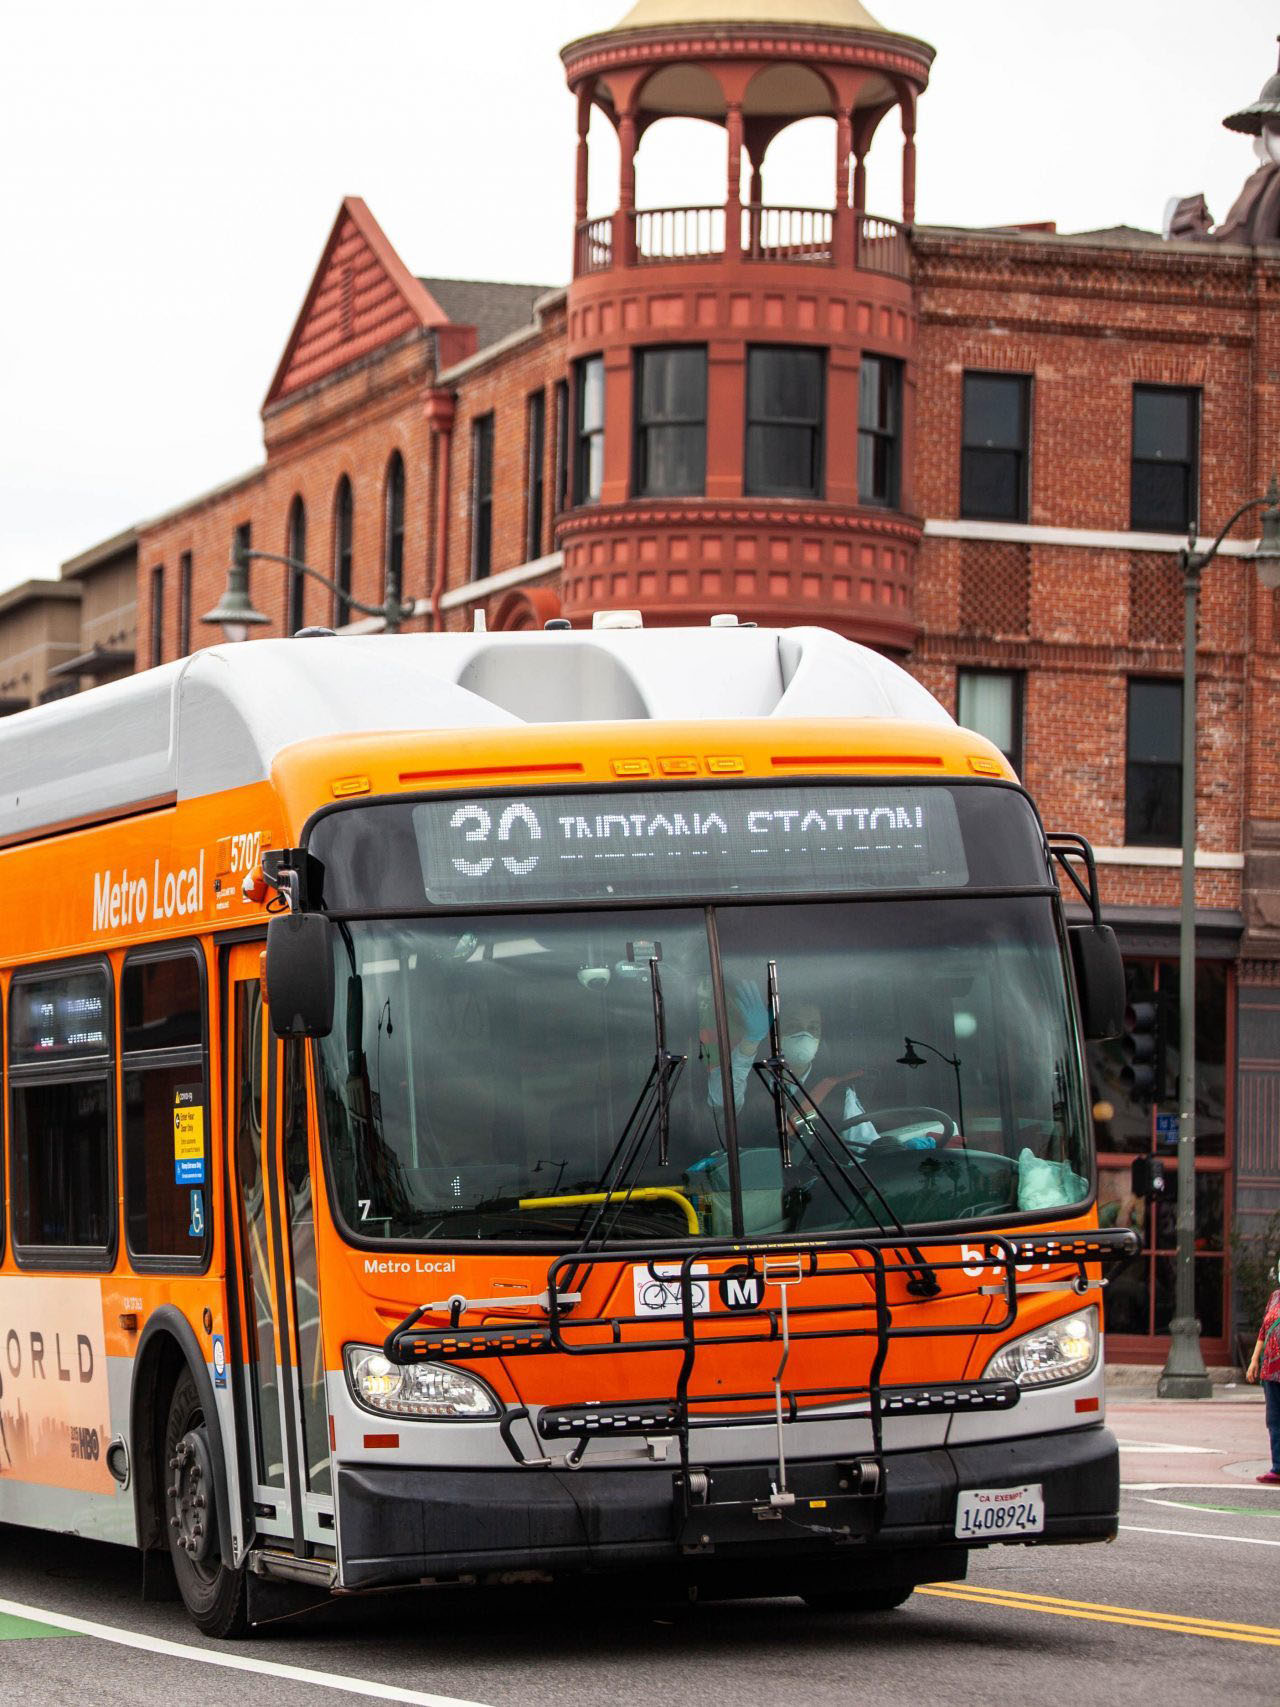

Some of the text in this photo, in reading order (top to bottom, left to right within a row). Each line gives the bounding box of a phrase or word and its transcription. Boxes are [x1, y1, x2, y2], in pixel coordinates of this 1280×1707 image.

[231, 831, 261, 873] 5707
[449, 803, 542, 876] 30
[93, 848, 204, 931] Metro Local
[364, 1258, 455, 1273] Metro Local
[726, 1279, 758, 1305] M
[79, 1427, 99, 1462] HBO
[979, 1492, 1023, 1503] CA EXEMPT
[962, 1503, 1038, 1531] 1408924
